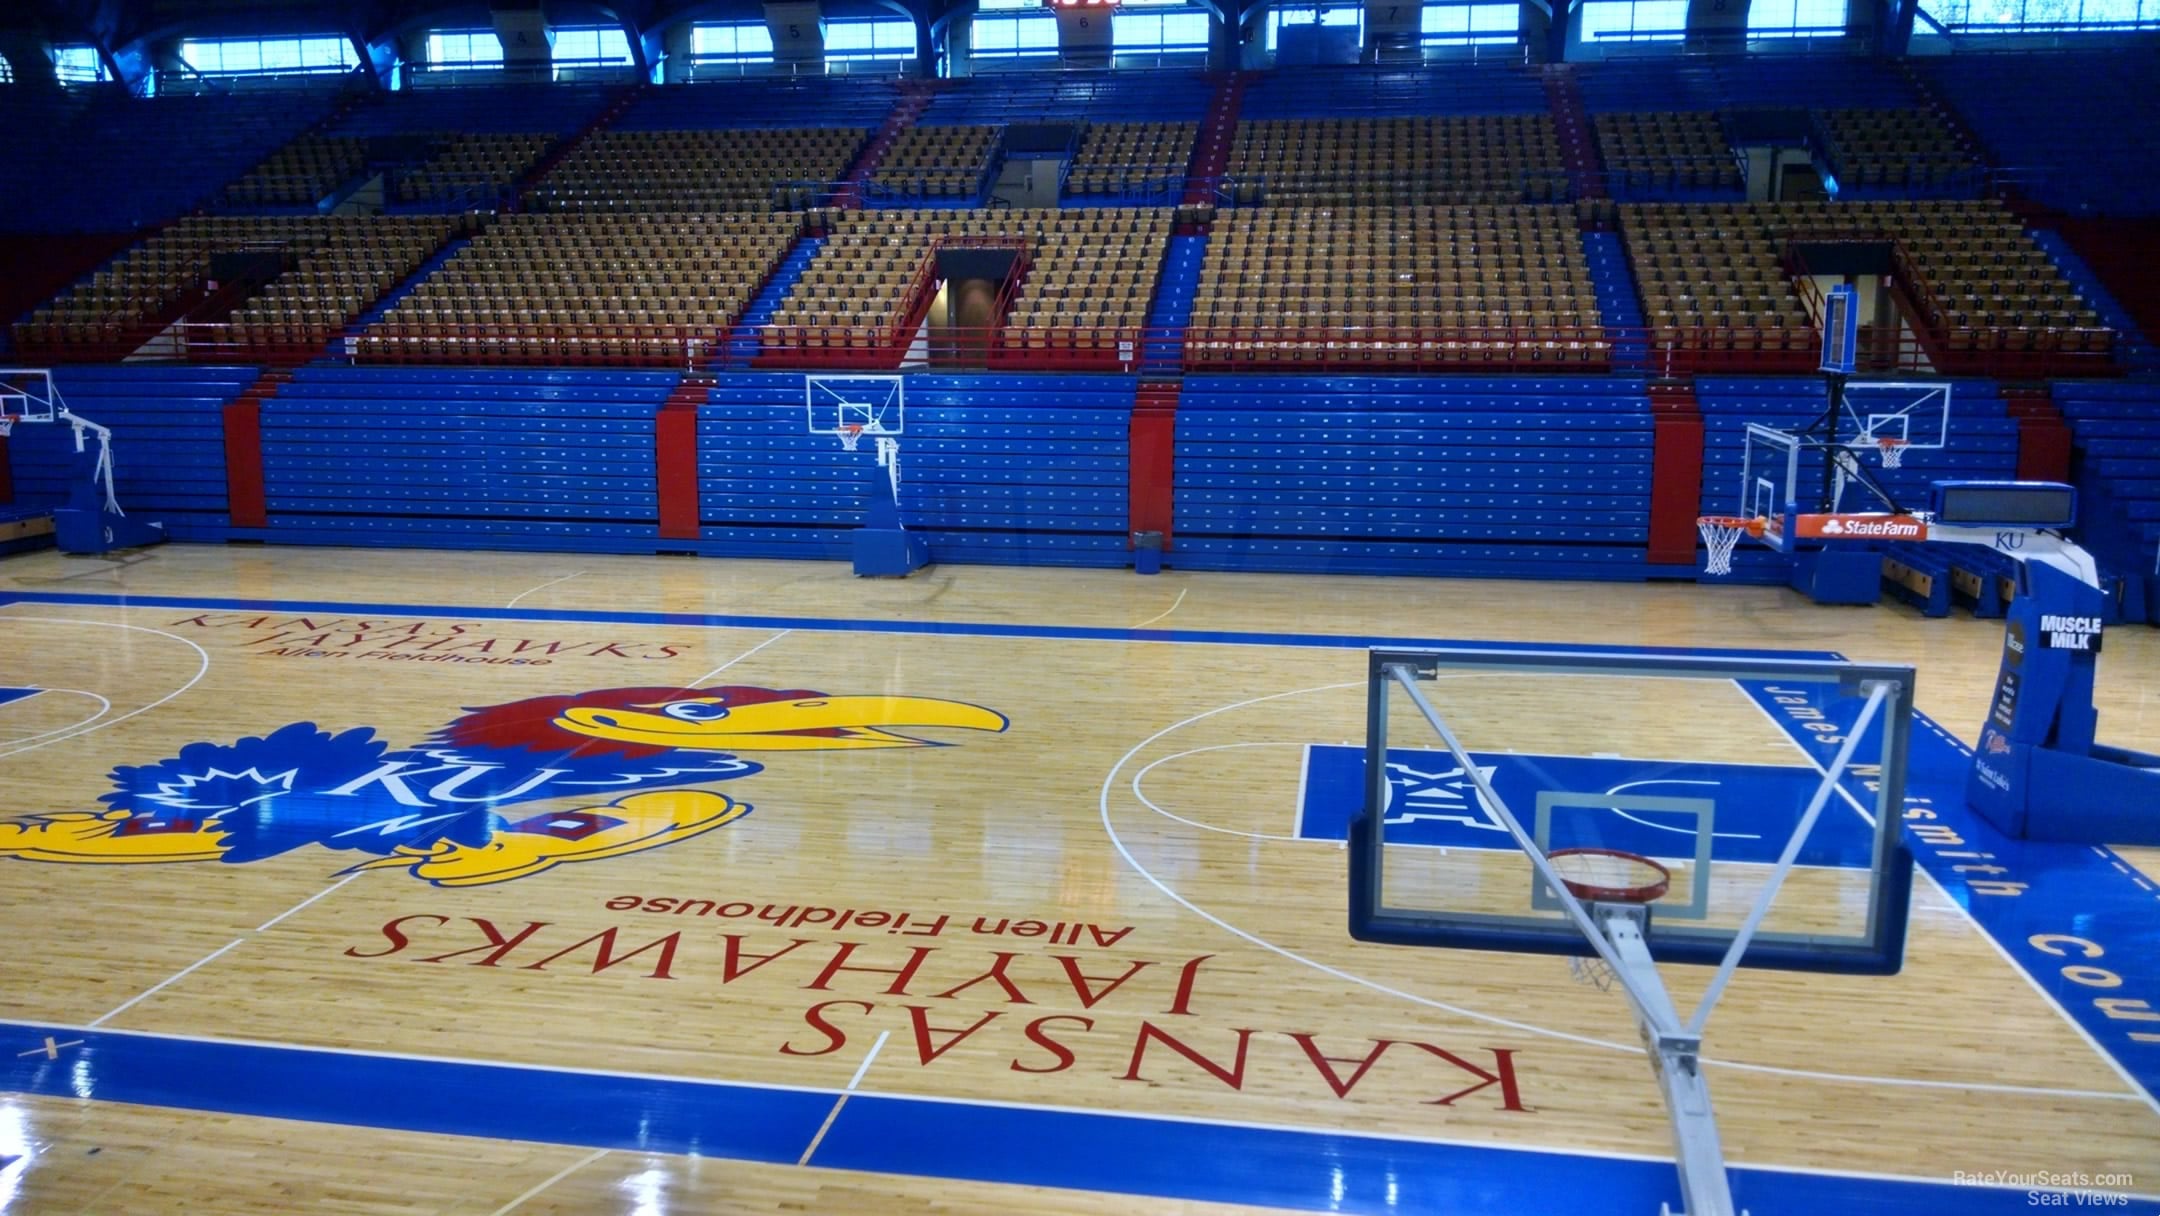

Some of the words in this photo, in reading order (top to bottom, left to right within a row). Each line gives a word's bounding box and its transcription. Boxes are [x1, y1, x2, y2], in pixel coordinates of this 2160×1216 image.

[1080, 17, 1089, 28] 6
[1388, 6, 1398, 21] 7
[518, 31, 527, 44] 4
[789, 24, 800, 38] 5
[1995, 531, 2024, 550] KU
[170, 614, 483, 636] KANSAS
[2040, 614, 2102, 634] MUSCLE
[232, 631, 691, 660] JAYHAWKS
[256, 647, 349, 658] Allen
[356, 650, 553, 666] Fieldhouse
[1764, 685, 1848, 745] James
[314, 761, 575, 807] KU
[605, 895, 951, 937] Fieldhouse
[972, 915, 1137, 948] Allen
[344, 914, 1216, 1015] JAYHAWKS
[779, 1000, 1539, 1112] KANSAS
